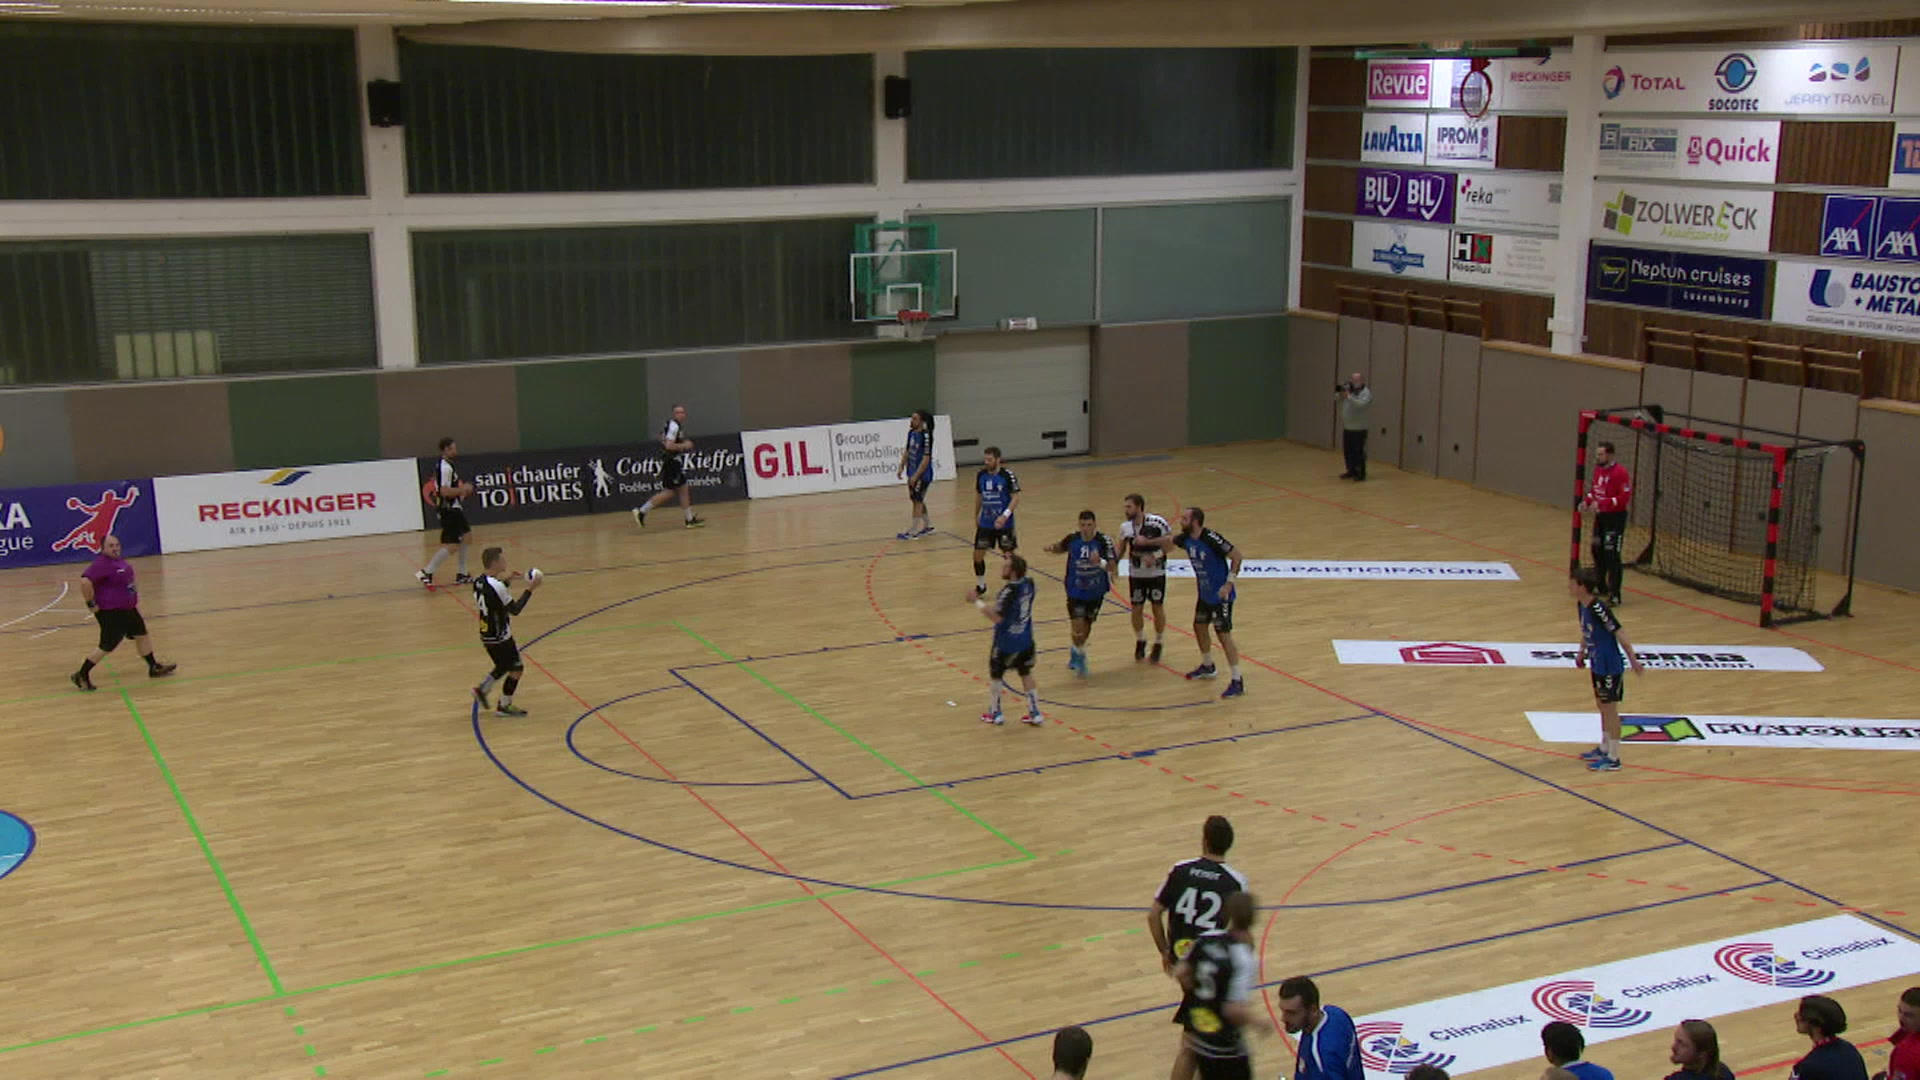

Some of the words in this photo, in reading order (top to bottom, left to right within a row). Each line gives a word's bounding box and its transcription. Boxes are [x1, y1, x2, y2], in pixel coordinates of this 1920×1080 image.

[1371, 64, 1426, 95] Revue
[1510, 71, 1572, 83] RECKINGER
[1630, 74, 1686, 91] TOTAL
[1708, 98, 1759, 111] SOCOTEC
[1785, 94, 1831, 106] JERRY
[1834, 94, 1889, 106] TRAVEL
[1363, 125, 1423, 153] LAVAZZA
[1437, 127, 1479, 145] IPROM
[1706, 136, 1771, 166] Quick
[1365, 176, 1392, 203] BIL
[1407, 178, 1436, 206] BIL
[1465, 186, 1494, 205] reka
[1822, 227, 1862, 252] AXA
[1877, 231, 1919, 257] AXA
[1631, 258, 1688, 282] Neptun
[1690, 266, 1751, 287] cruises
[1682, 291, 1750, 308] Luxembourg
[835, 433, 880, 447] Groupe
[616, 457, 662, 476] Cotty
[682, 449, 744, 472] Kieffer
[753, 440, 829, 479] G.I.L.
[198, 491, 377, 522] RECKINGER
[477, 481, 584, 509] TOITURES
[288, 520, 324, 531] DEPUIS
[1175, 887, 1223, 929] 42
[1801, 935, 1896, 961] Climalux
[1622, 972, 1720, 1000] Climalux
[1429, 1013, 1533, 1042] Climalux
